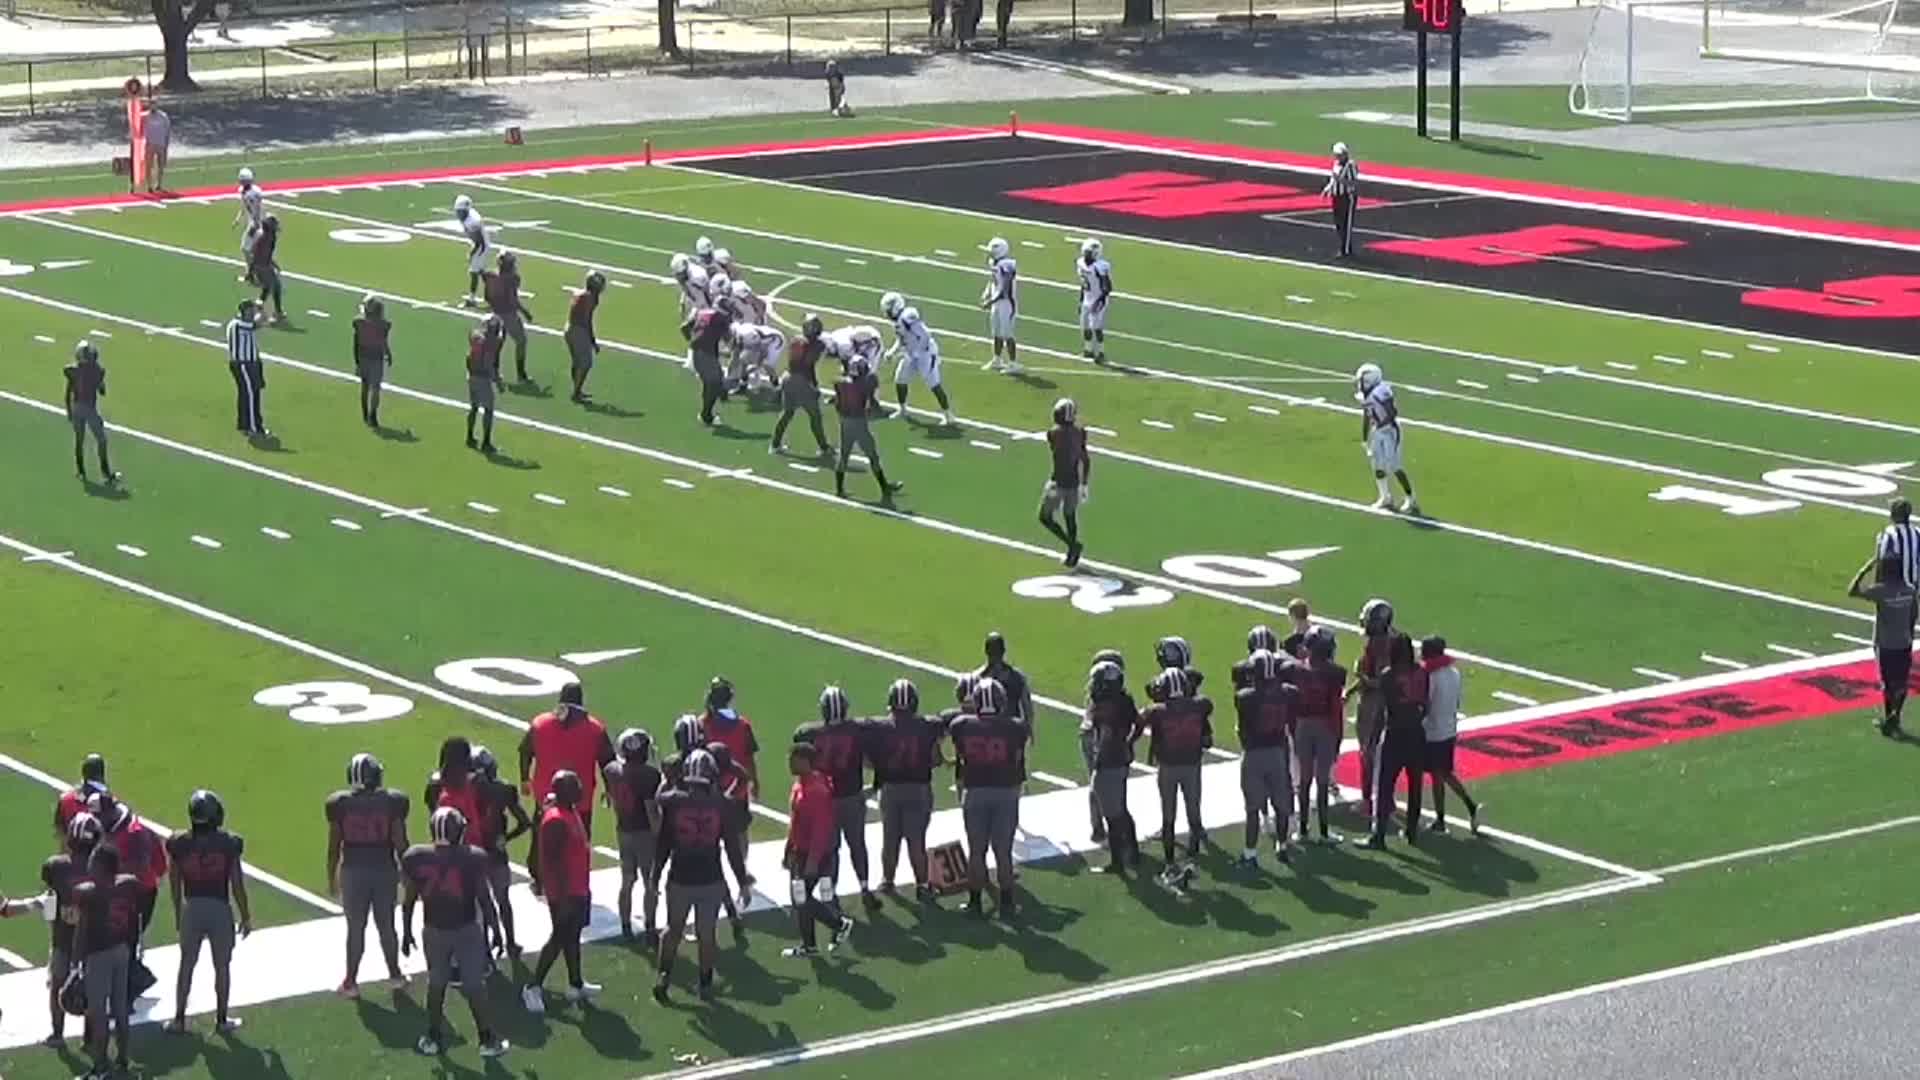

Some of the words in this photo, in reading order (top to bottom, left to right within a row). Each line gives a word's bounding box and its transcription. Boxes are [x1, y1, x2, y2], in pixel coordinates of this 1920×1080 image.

[1647, 468, 1898, 516] 10
[1011, 555, 1302, 614] 20
[253, 657, 581, 723] 30
[1458, 691, 1792, 759] ONCE
[933, 844, 968, 884] 30
